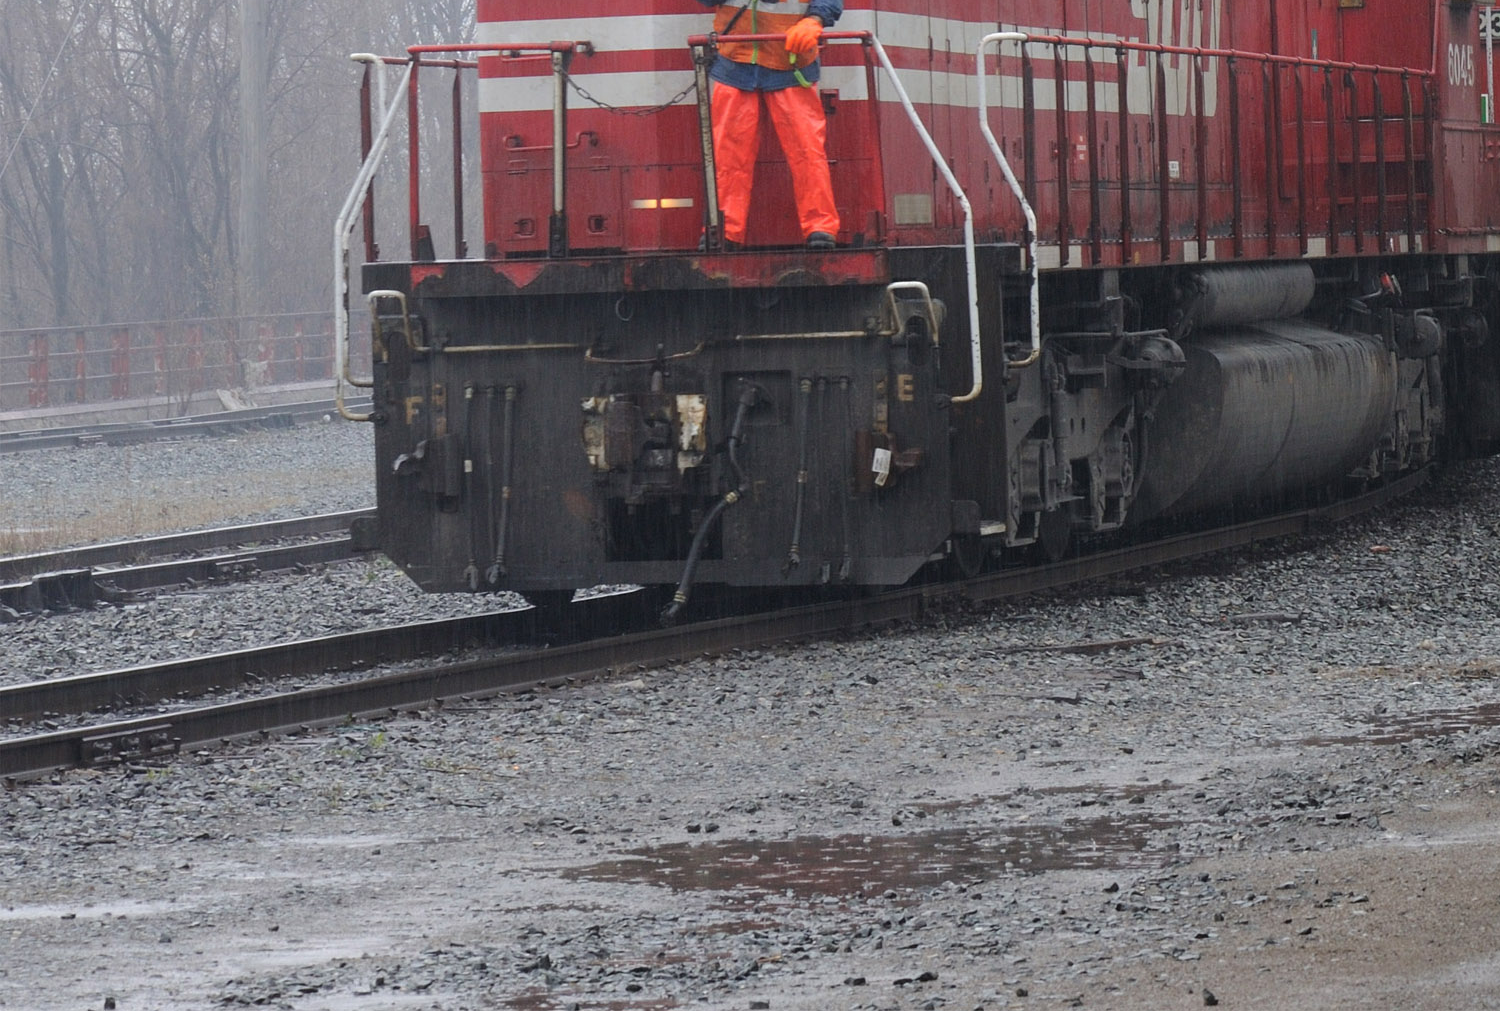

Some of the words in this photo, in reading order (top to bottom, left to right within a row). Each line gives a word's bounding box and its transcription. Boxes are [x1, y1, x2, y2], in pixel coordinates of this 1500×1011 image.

[1448, 42, 1475, 88] 6045
[897, 374, 914, 401] E
[405, 395, 424, 425] F
